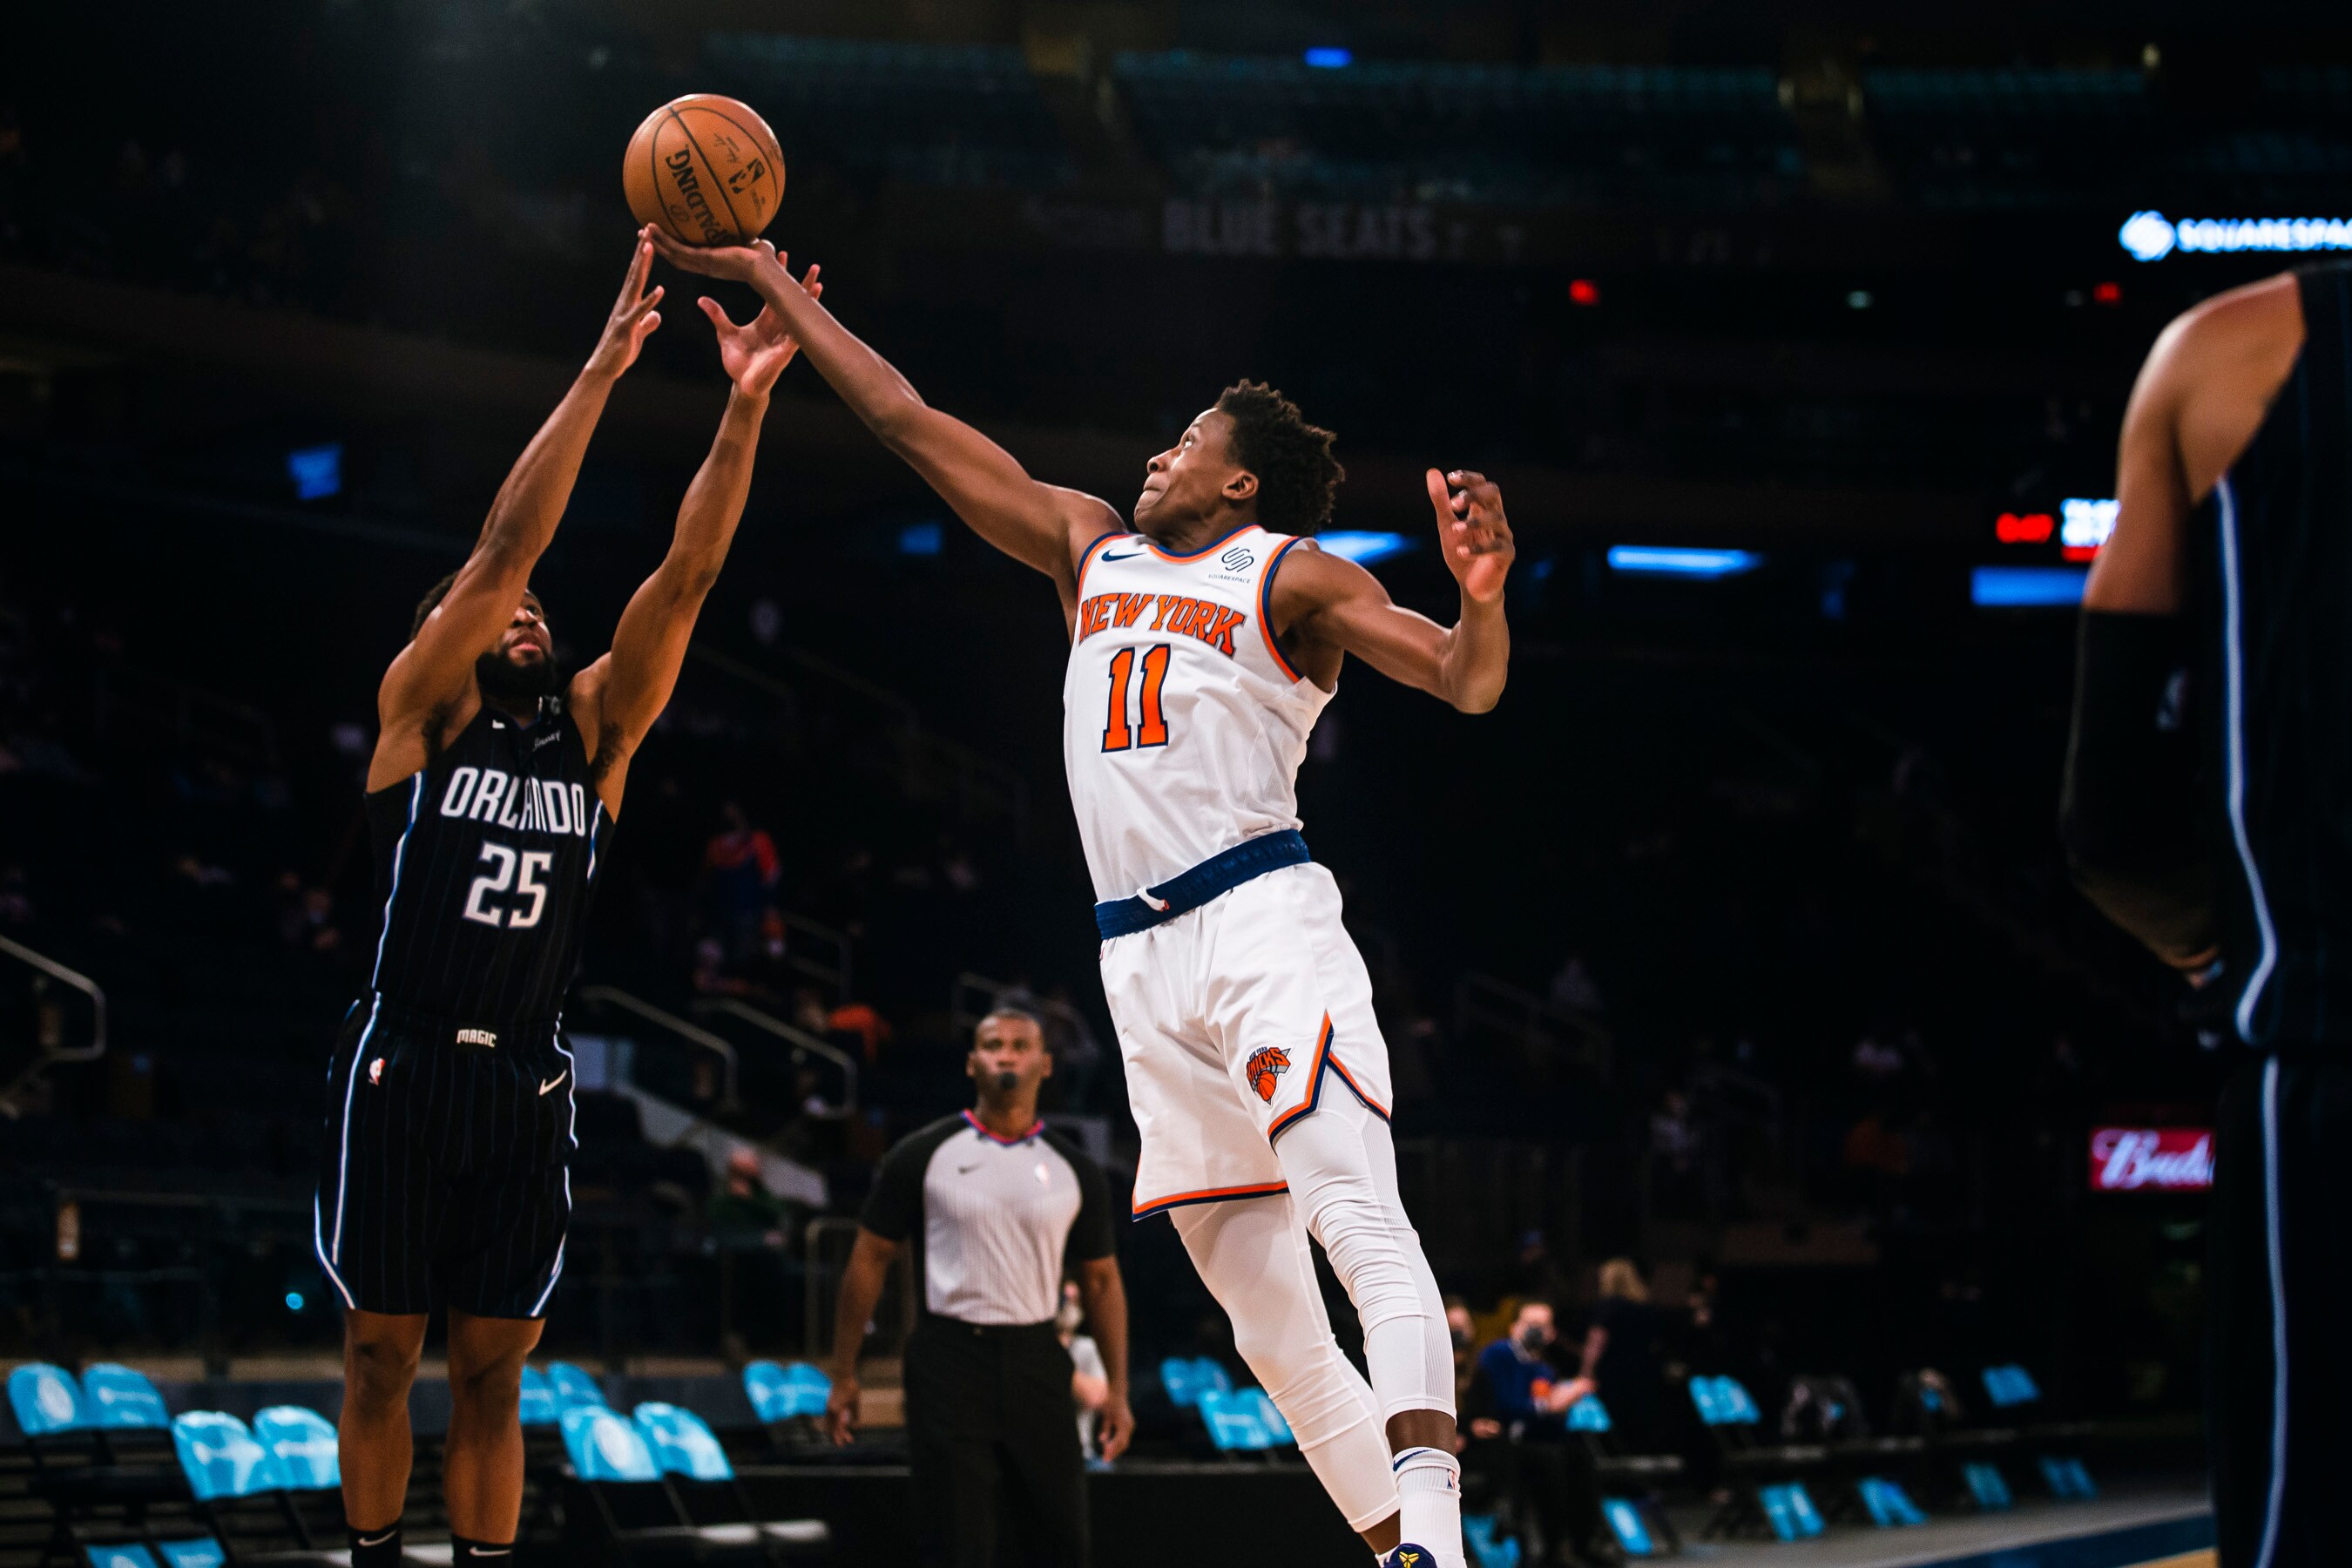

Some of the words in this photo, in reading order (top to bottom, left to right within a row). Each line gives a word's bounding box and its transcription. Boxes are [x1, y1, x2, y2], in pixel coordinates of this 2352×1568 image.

[1161, 199, 1280, 253] BLUE
[1296, 202, 1436, 260] SEATS
[1208, 574, 1251, 584] SQUARESPACE
[1079, 593, 1153, 646] NEW
[1149, 594, 1248, 659] YORK
[1101, 643, 1171, 754] 11
[440, 766, 587, 837] ORLANDO
[463, 841, 554, 929] 25
[456, 1029, 497, 1048] MAGIC
[1247, 1047, 1291, 1085] KNICKS
